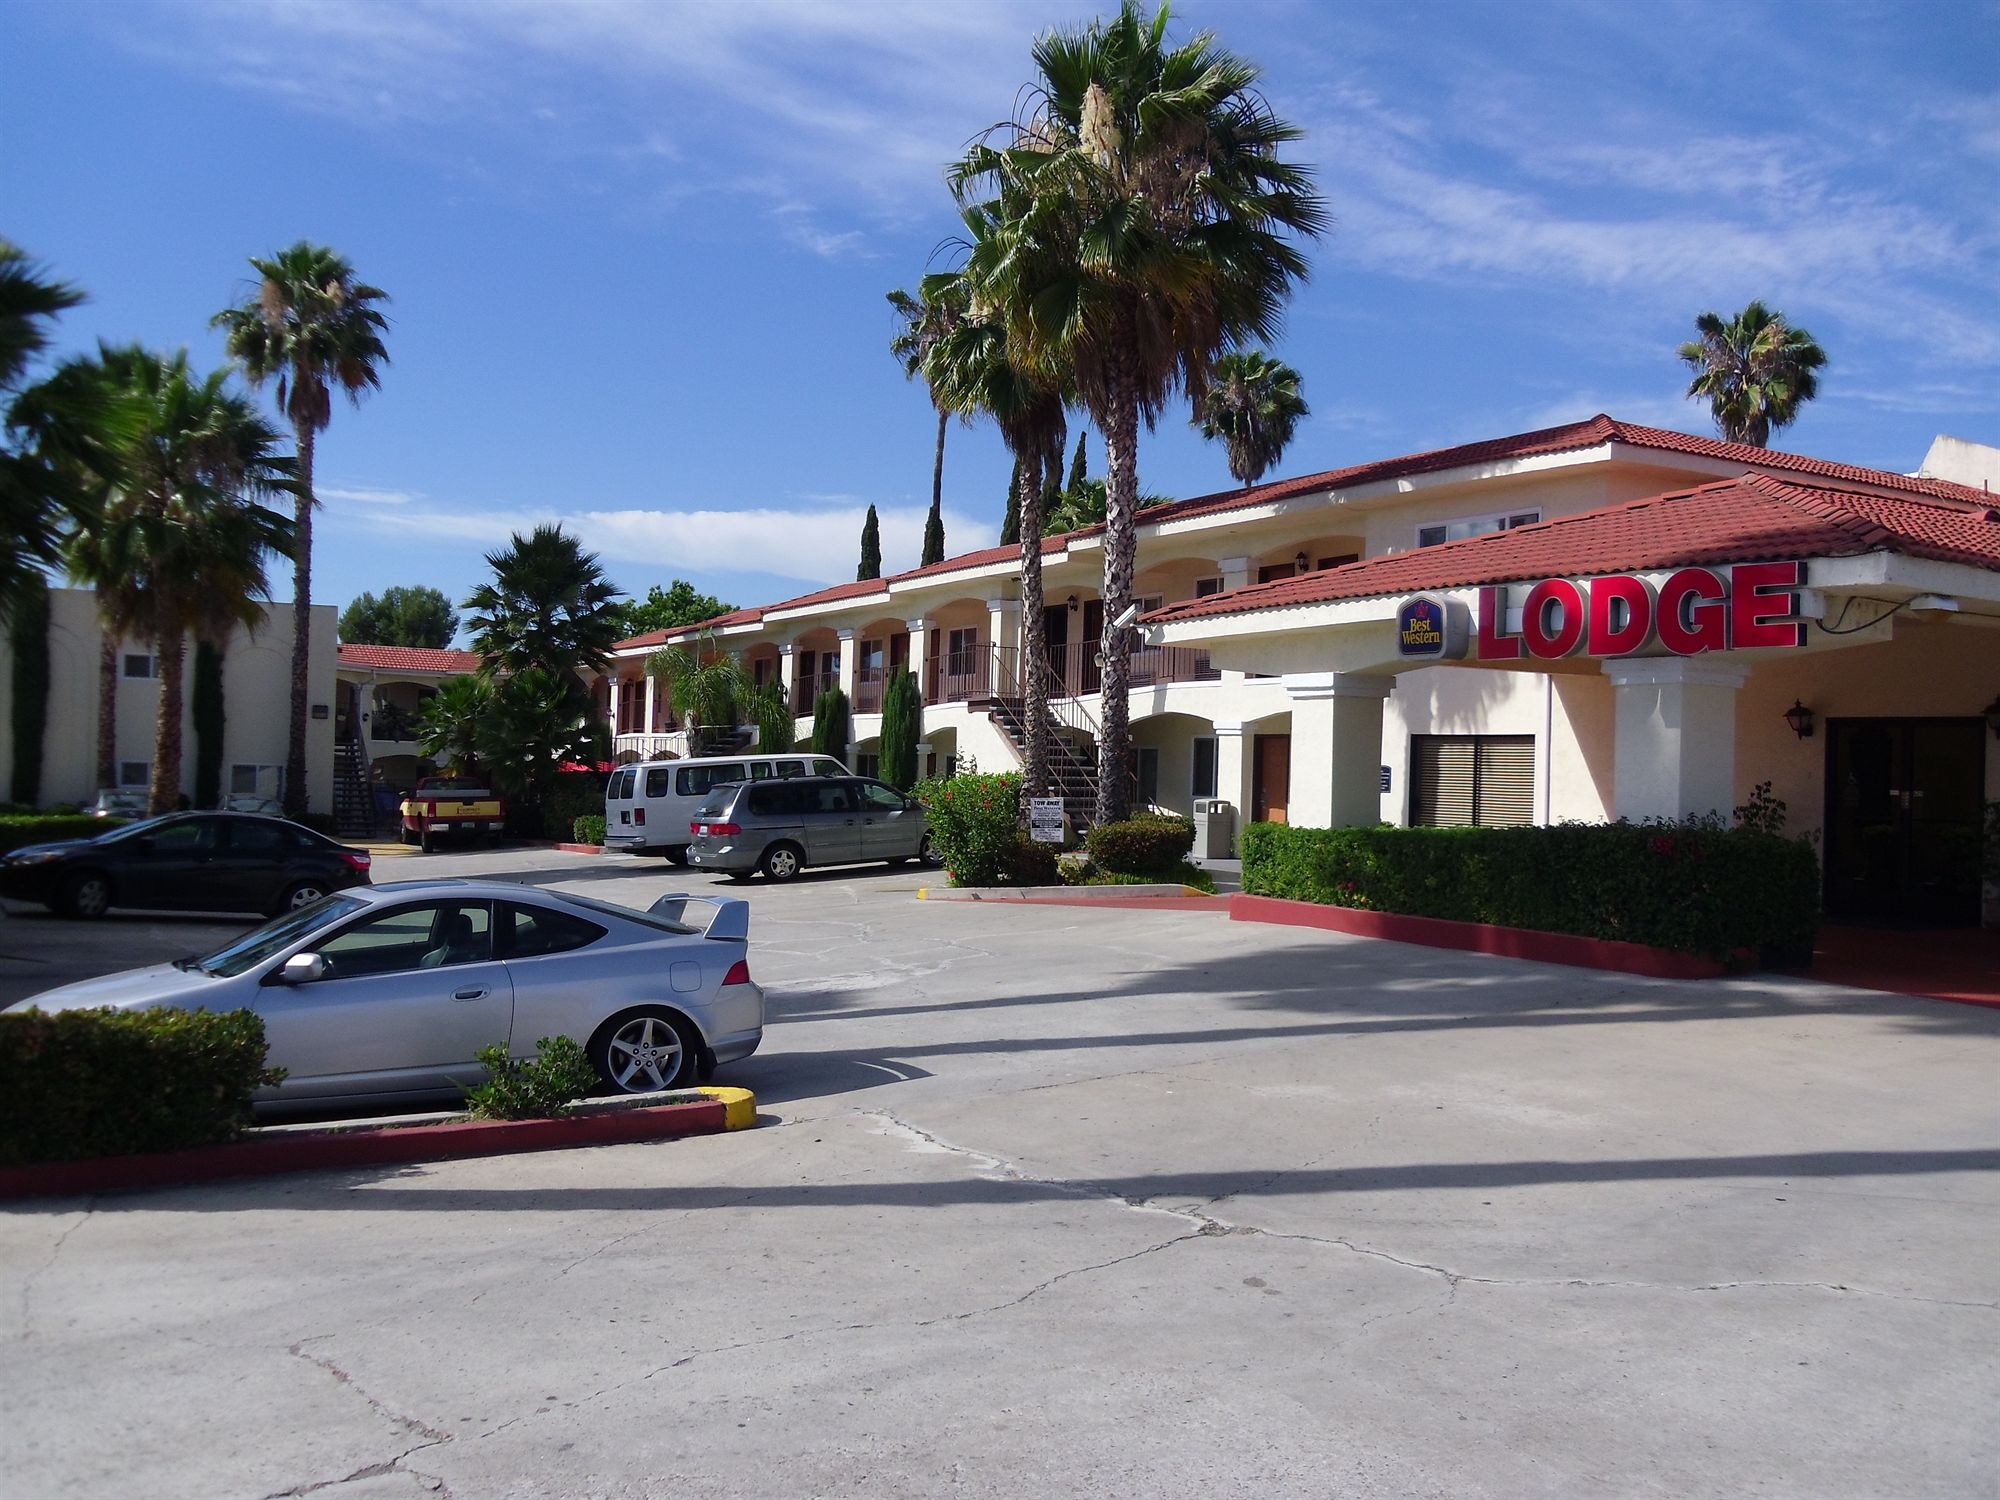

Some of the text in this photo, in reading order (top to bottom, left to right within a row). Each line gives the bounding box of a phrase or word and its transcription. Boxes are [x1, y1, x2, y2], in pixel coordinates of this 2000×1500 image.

[1477, 560, 1800, 660] LODGE
[1410, 618, 1431, 632] Best
[1402, 631, 1441, 645] Western
